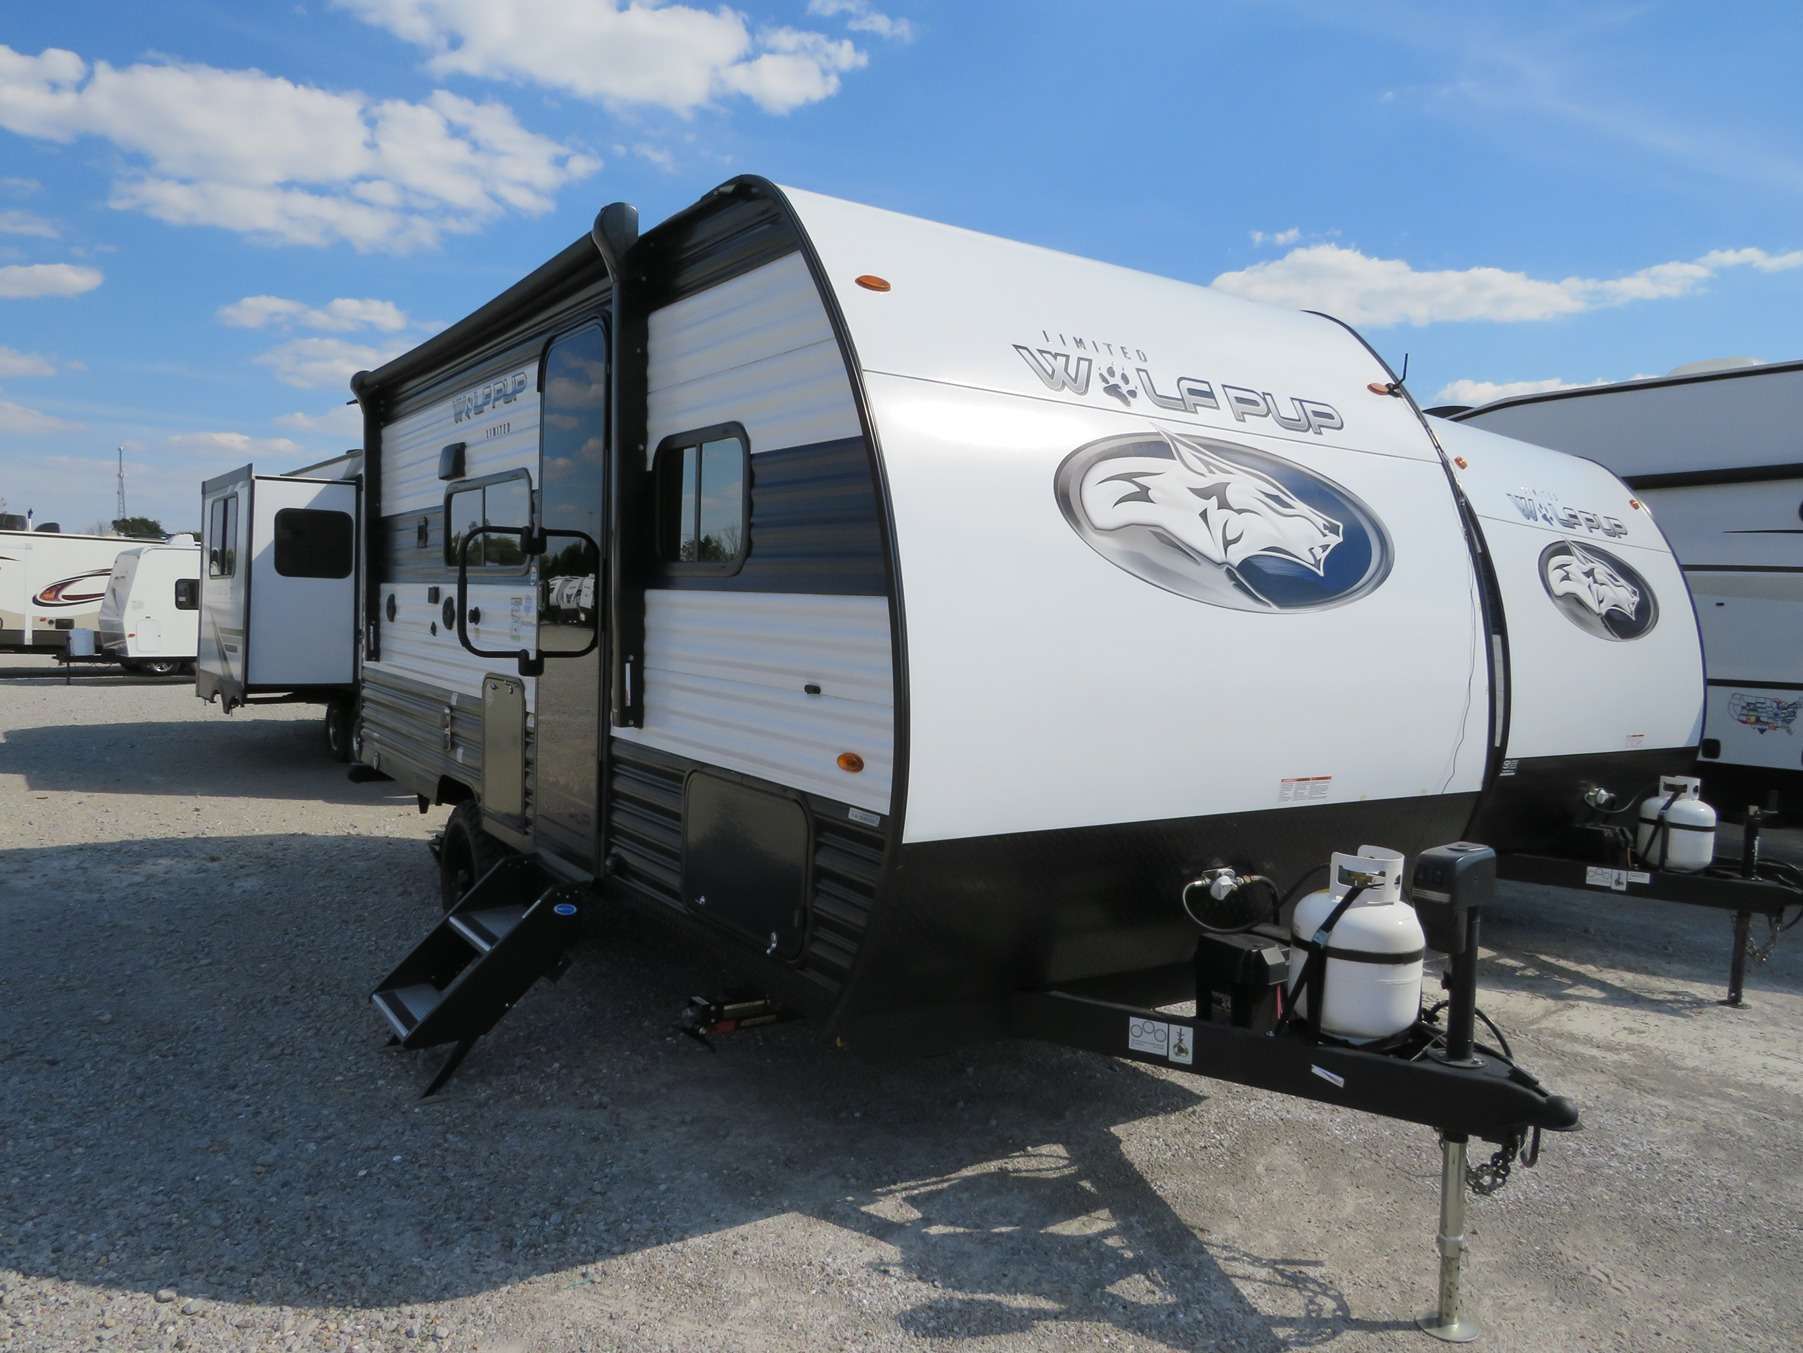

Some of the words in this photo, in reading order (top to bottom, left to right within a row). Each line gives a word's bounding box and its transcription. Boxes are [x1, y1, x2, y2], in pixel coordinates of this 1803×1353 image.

[1042, 329, 1148, 363] LIMITED
[452, 385, 492, 424] WLF
[1011, 343, 1220, 415] WLF
[1221, 383, 1345, 435] PUP
[1505, 493, 1582, 530] WLF
